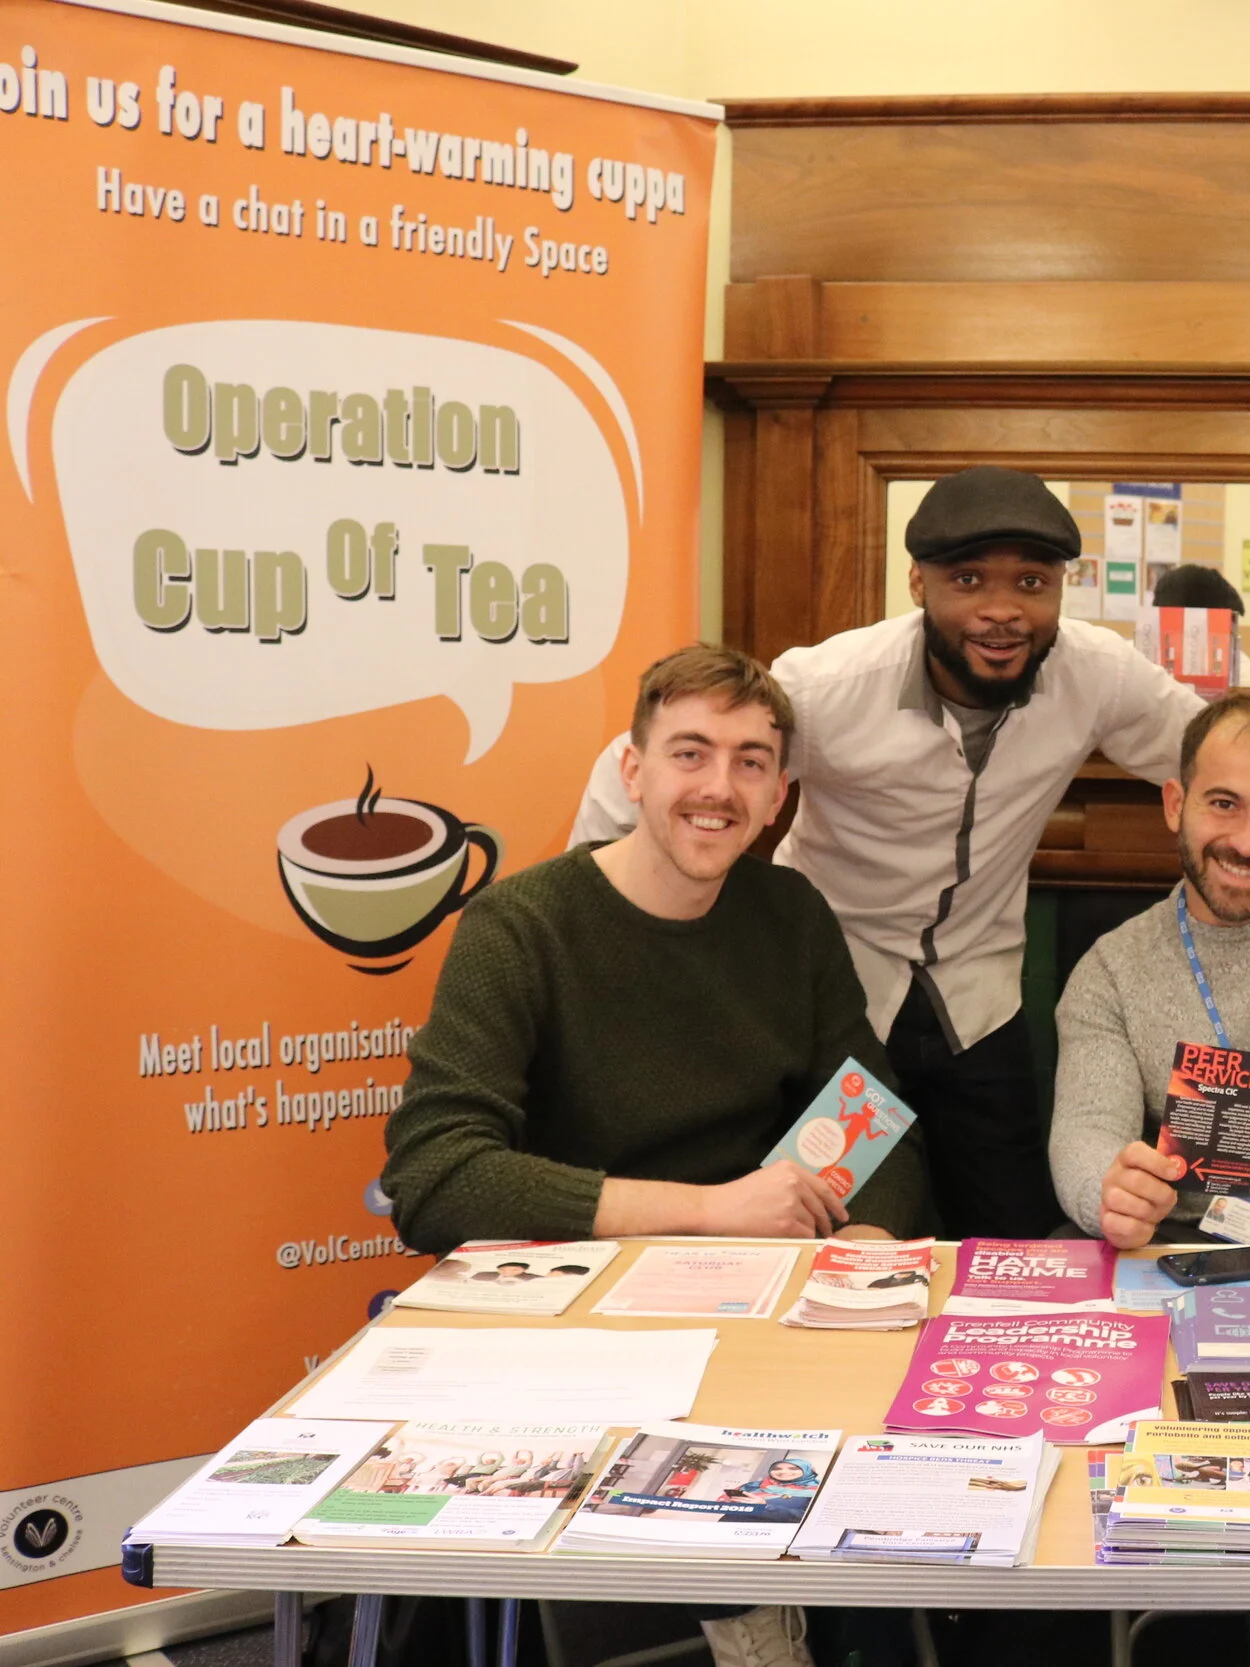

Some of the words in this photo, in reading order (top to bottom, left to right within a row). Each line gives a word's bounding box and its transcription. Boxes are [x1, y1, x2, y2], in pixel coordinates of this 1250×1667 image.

[0, 45, 68, 121] oin
[86, 70, 140, 129] us
[156, 65, 224, 144] for
[238, 101, 264, 149] a
[281, 86, 573, 211] heart-warming
[588, 156, 686, 222] cuppa
[96, 166, 186, 222] Have
[199, 194, 219, 226] a
[233, 185, 305, 238] chat
[316, 199, 346, 243] in
[359, 214, 378, 247] a
[390, 205, 513, 272] friendly
[524, 226, 609, 277] Space
[162, 363, 520, 475] Operation
[133, 528, 306, 643] Cup
[326, 517, 398, 599] Of
[422, 543, 569, 643] Tea
[140, 1033, 203, 1077] Meet
[211, 1021, 271, 1071] local
[279, 1017, 421, 1073] organisatio
[1183, 1045, 1243, 1072] PEER
[865, 1087, 887, 1107] GOT
[1198, 1083, 1224, 1095] Spectra
[1225, 1088, 1239, 1097] CIC
[184, 1085, 268, 1133] what's
[971, 1255, 1068, 1269] HATE
[969, 1265, 1088, 1279] CRIME
[947, 1323, 1133, 1340] Leadership
[1024, 1319, 1135, 1331] Community
[943, 1334, 1138, 1349] Programme
[415, 1421, 482, 1432] HEALTH
[489, 1426, 500, 1434] &
[510, 1425, 601, 1434] STRENGTH
[721, 1430, 829, 1439] healthwatch
[1154, 1425, 1220, 1433] Volunteering
[52, 1493, 83, 1522] centre
[622, 1495, 671, 1508] Impact
[671, 1500, 719, 1513] Report
